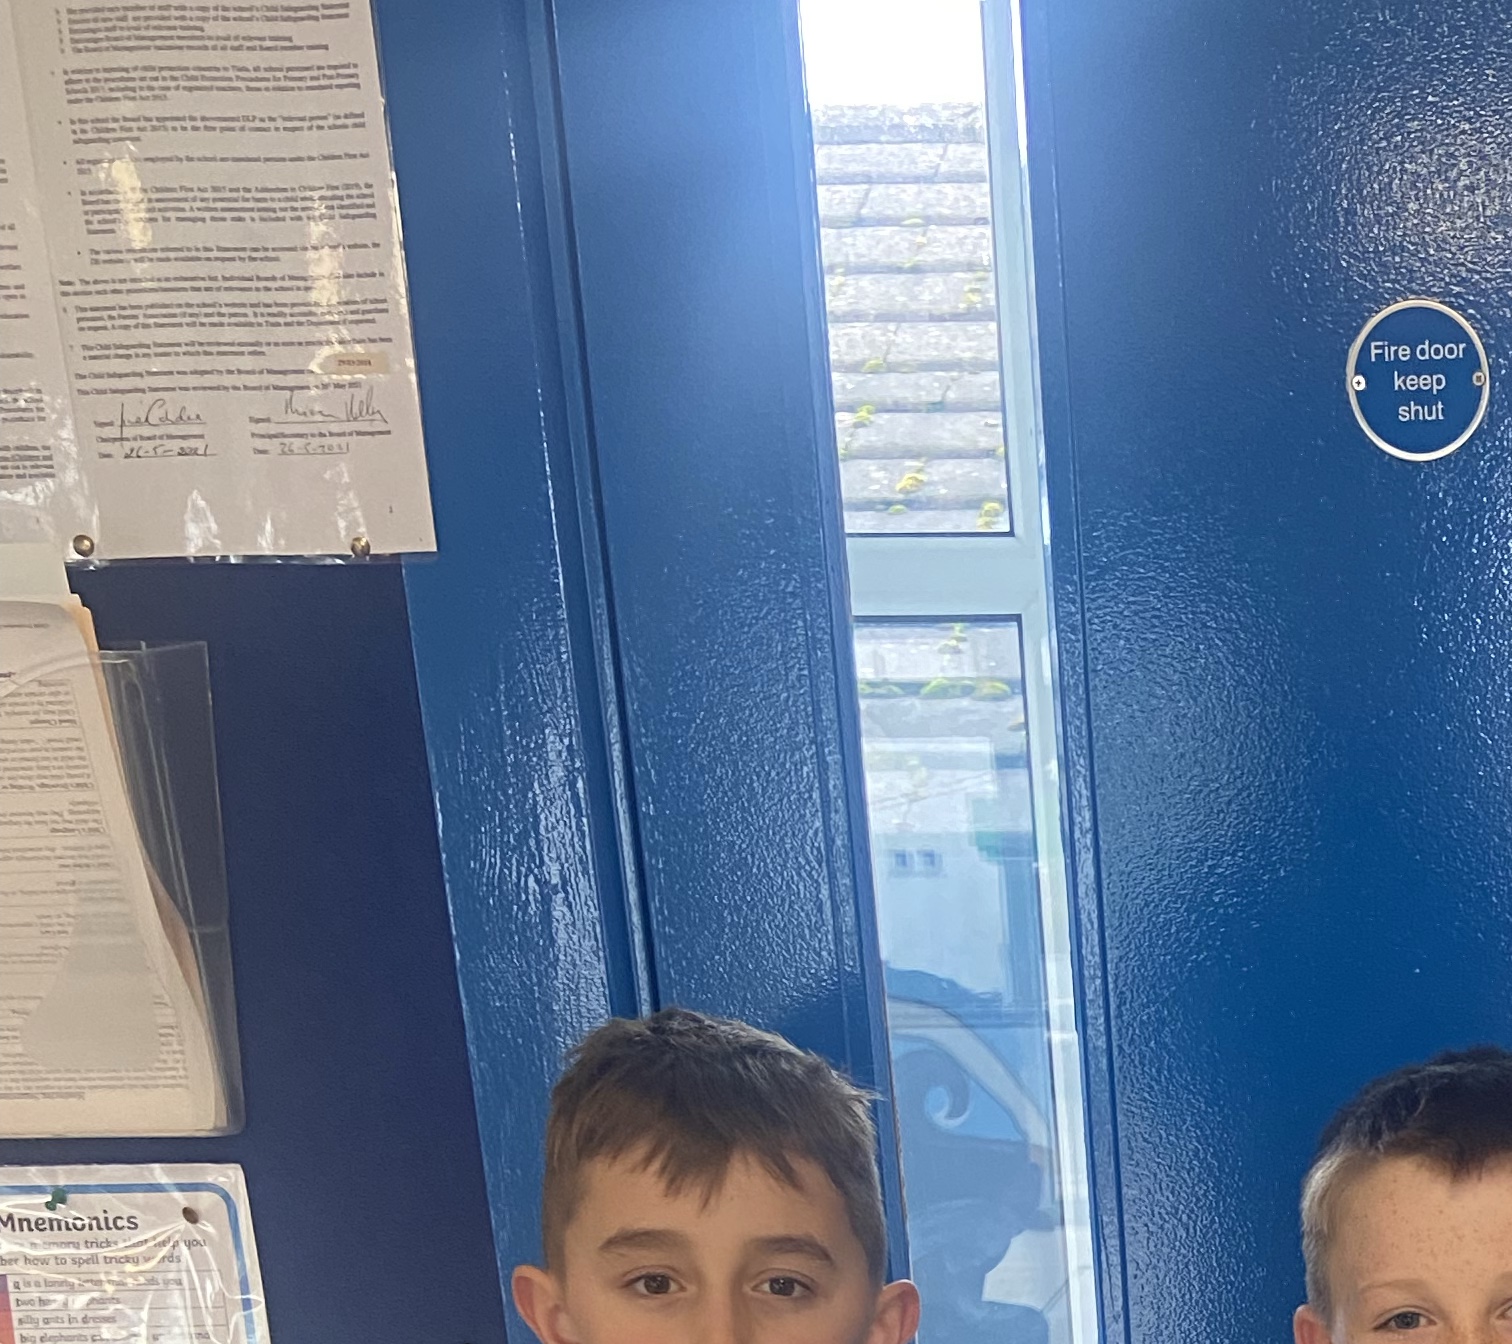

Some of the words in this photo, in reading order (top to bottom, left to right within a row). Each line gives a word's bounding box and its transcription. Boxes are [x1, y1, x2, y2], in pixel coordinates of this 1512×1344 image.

[1370, 341, 1411, 362] Fire
[1416, 340, 1466, 360] door
[1394, 371, 1446, 395] keep
[1398, 401, 1444, 422] shut
[0, 1209, 139, 1232] Mnemonics
[24, 1255, 49, 1266] how
[55, 1255, 67, 1266] to
[71, 1254, 99, 1268] spell
[143, 1252, 181, 1264] wrds
